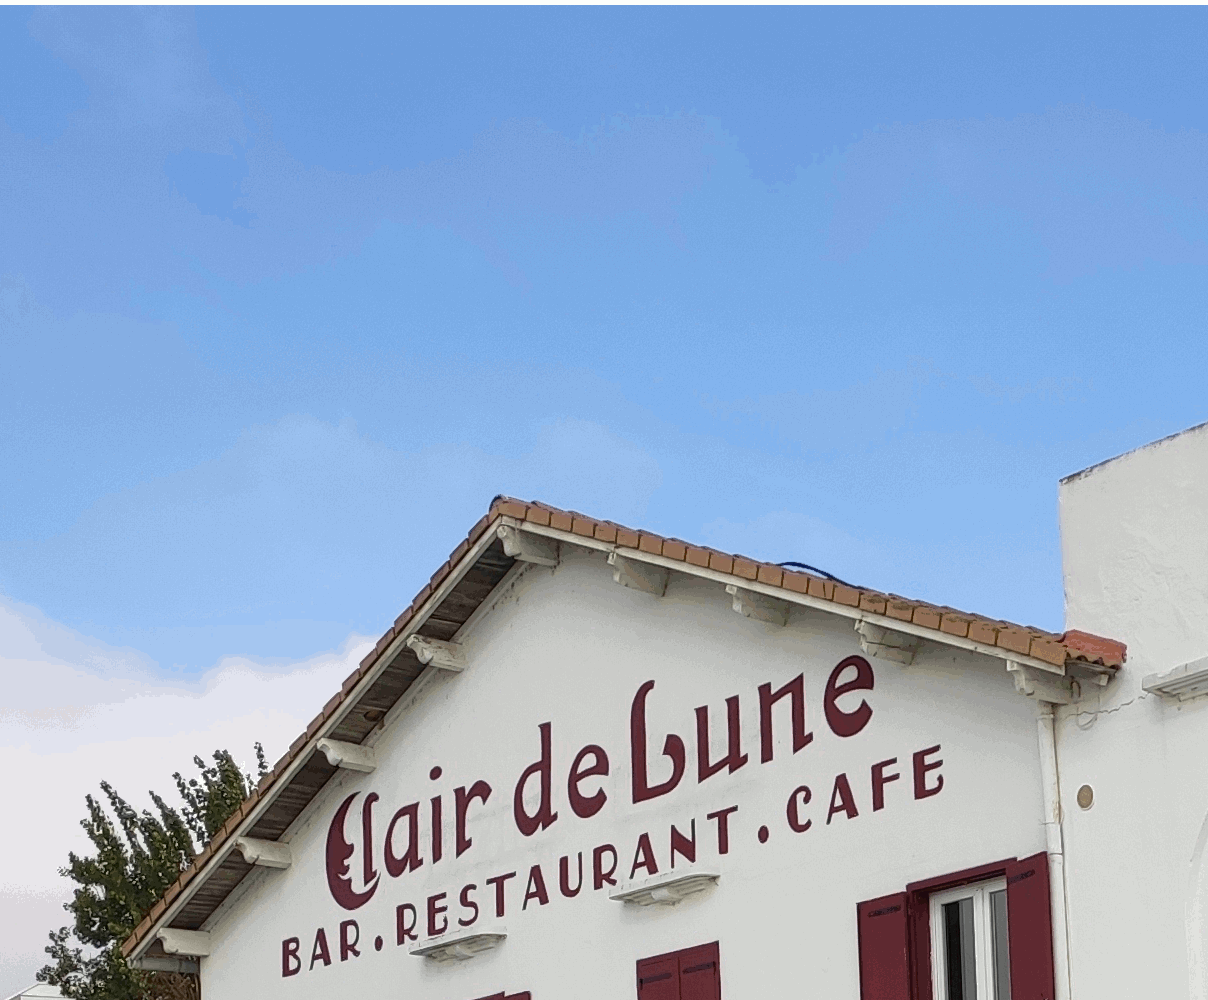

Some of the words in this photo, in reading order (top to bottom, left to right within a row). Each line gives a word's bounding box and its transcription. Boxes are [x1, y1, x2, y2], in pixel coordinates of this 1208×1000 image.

[326, 766, 492, 910] Clair
[513, 721, 610, 837] de
[630, 655, 875, 804] Lune
[786, 744, 944, 833] CAFE
